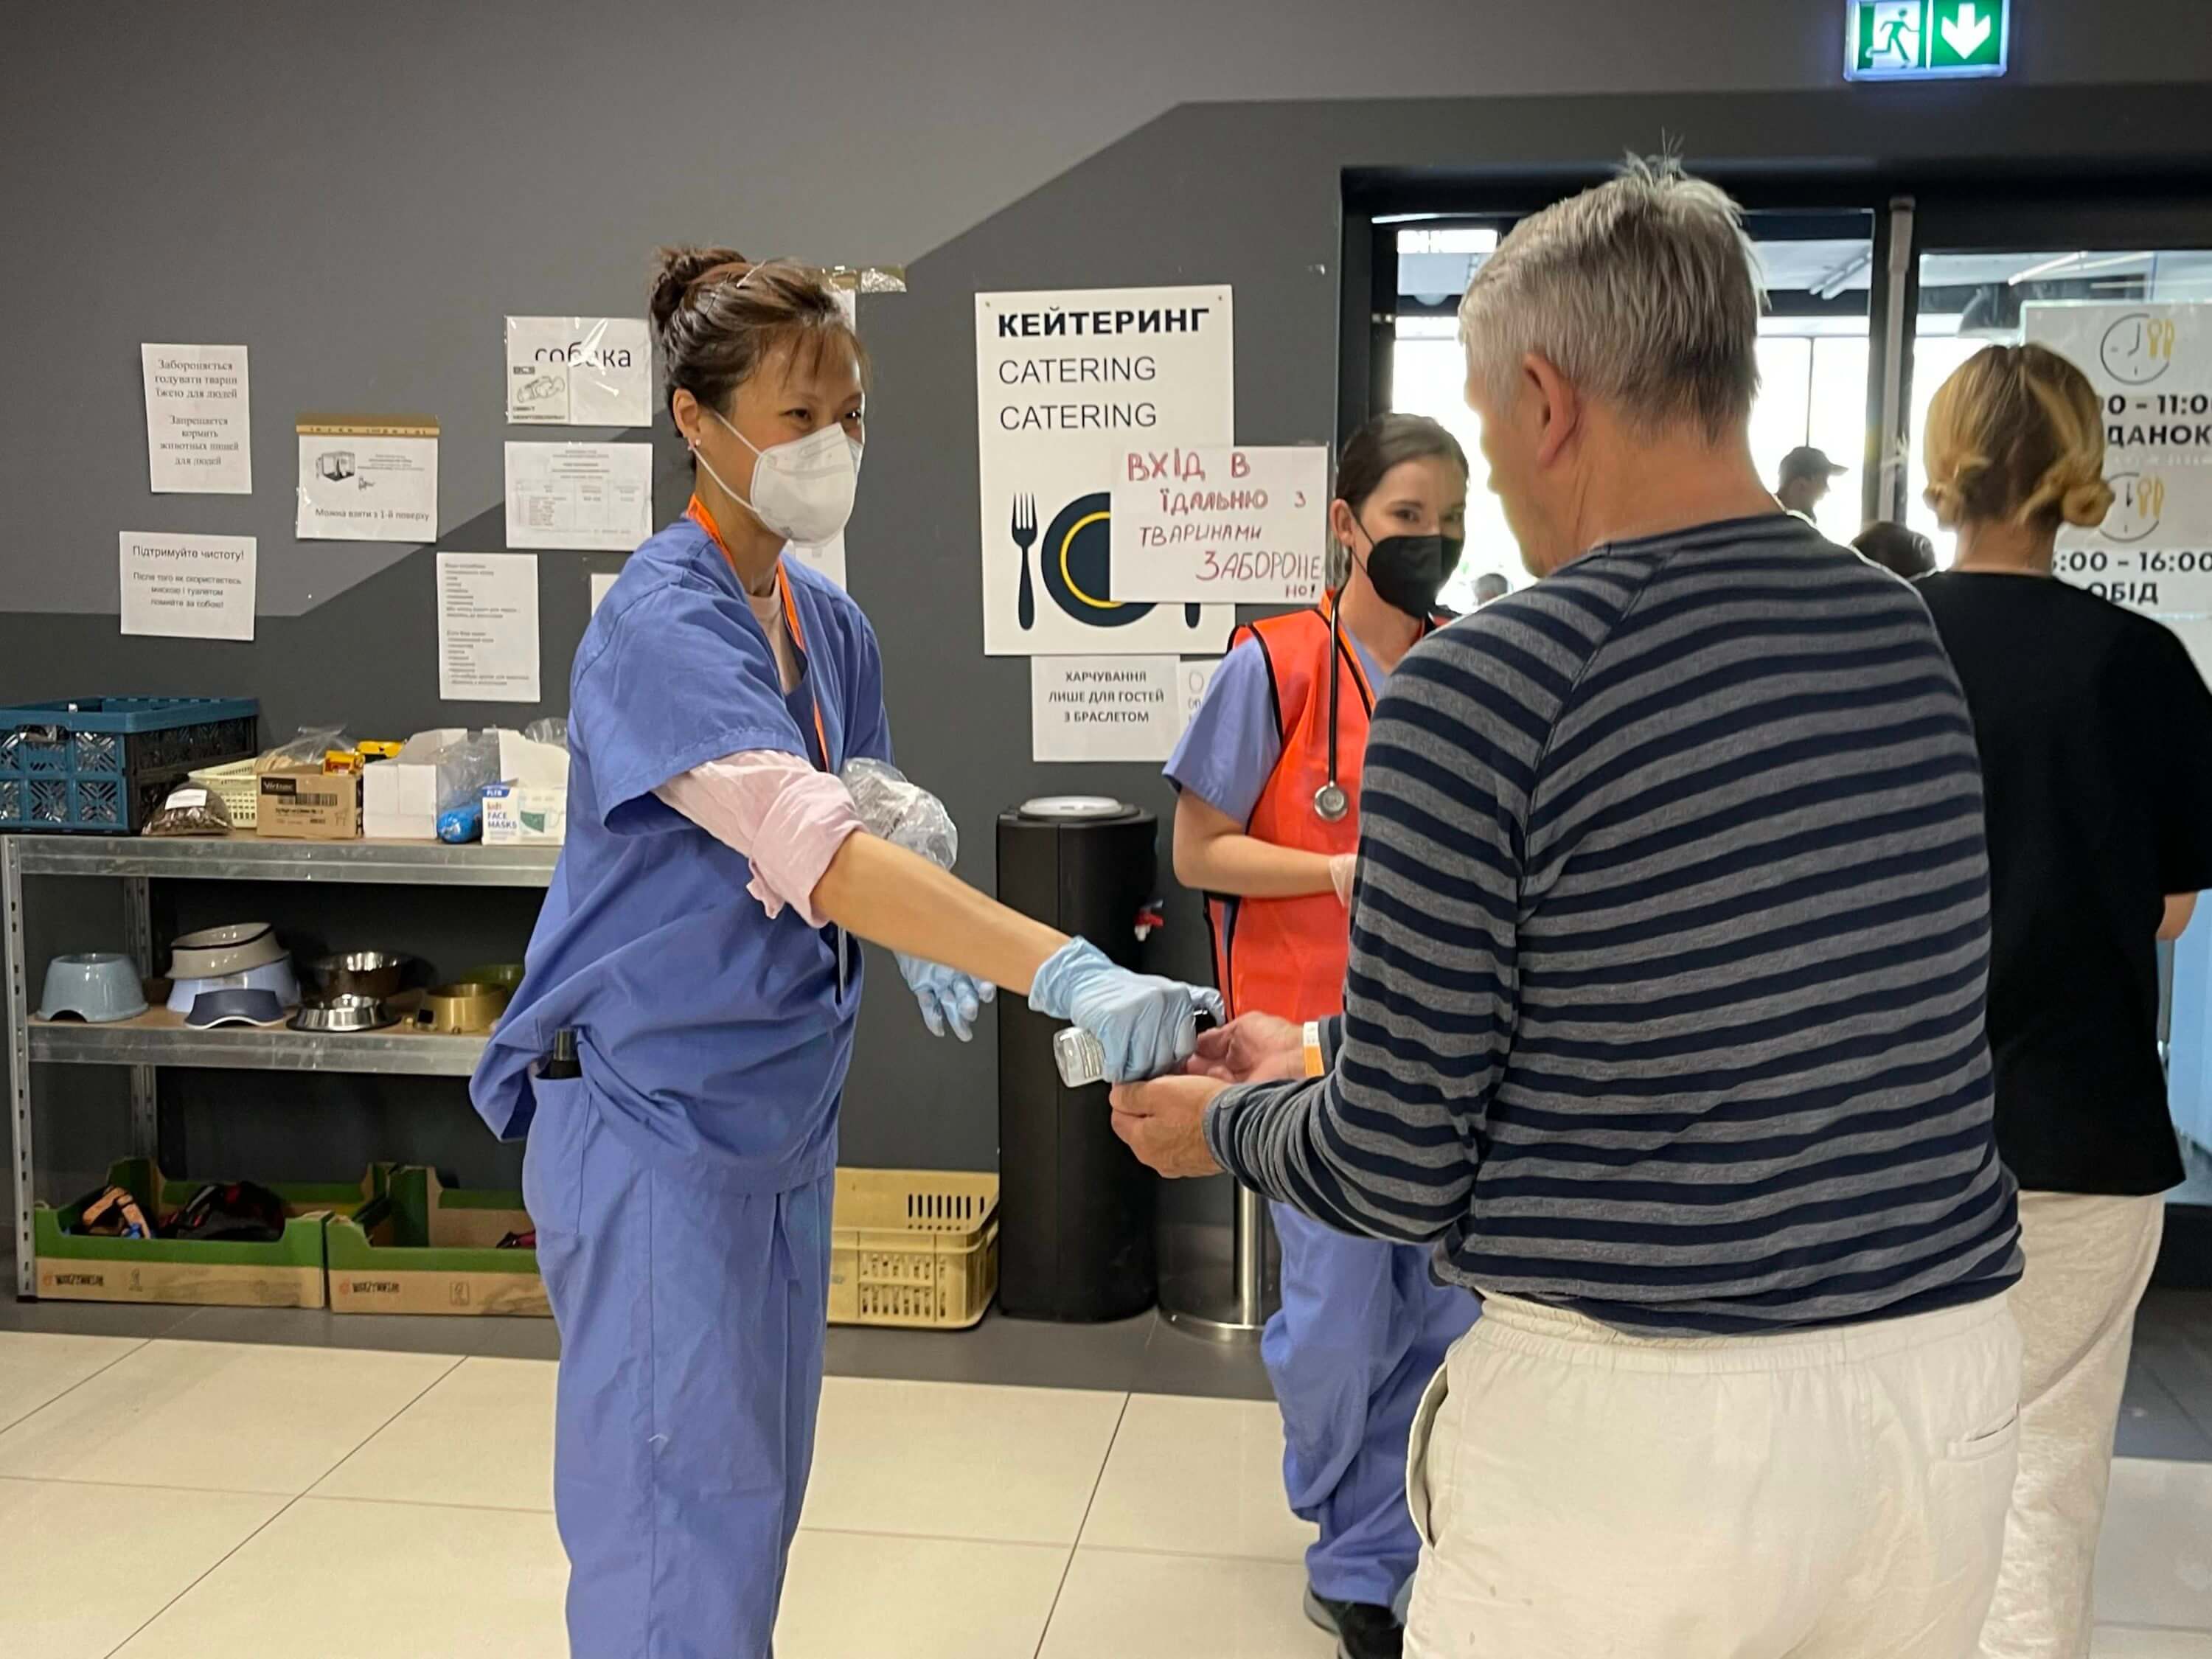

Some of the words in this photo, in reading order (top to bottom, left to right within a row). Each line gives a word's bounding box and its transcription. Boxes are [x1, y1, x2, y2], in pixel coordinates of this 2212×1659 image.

[998, 307, 1209, 338] КЕЙТЕРИНГ
[998, 356, 1156, 384] CATERING
[154, 375, 201, 386] годувати
[187, 391, 204, 399] для
[2157, 394, 2212, 415] 11:0
[1000, 403, 1157, 431] CATERING
[1127, 448, 1206, 481] ВХІД
[1231, 452, 1251, 479] В
[1159, 487, 1269, 516] ЇДАЛЬНЮ
[315, 508, 347, 517] Можна
[1140, 524, 1262, 548] ТВАРИНАМИ
[201, 549, 244, 563] чистоту!
[1195, 550, 1321, 582] ЗАБОРОНЕ
[2053, 552, 2108, 572] :00
[2140, 552, 2212, 572] 16:00
[1065, 671, 1147, 683] ХАРЧУВАННЯ
[1048, 691, 1085, 703] ЛИШЕ
[1088, 692, 1115, 704] ДЛЯ
[1119, 688, 1165, 703] ГОСТЕЙ
[1074, 712, 1150, 723] БРАСЛЕТОМ
[488, 819, 517, 829] MASKS
